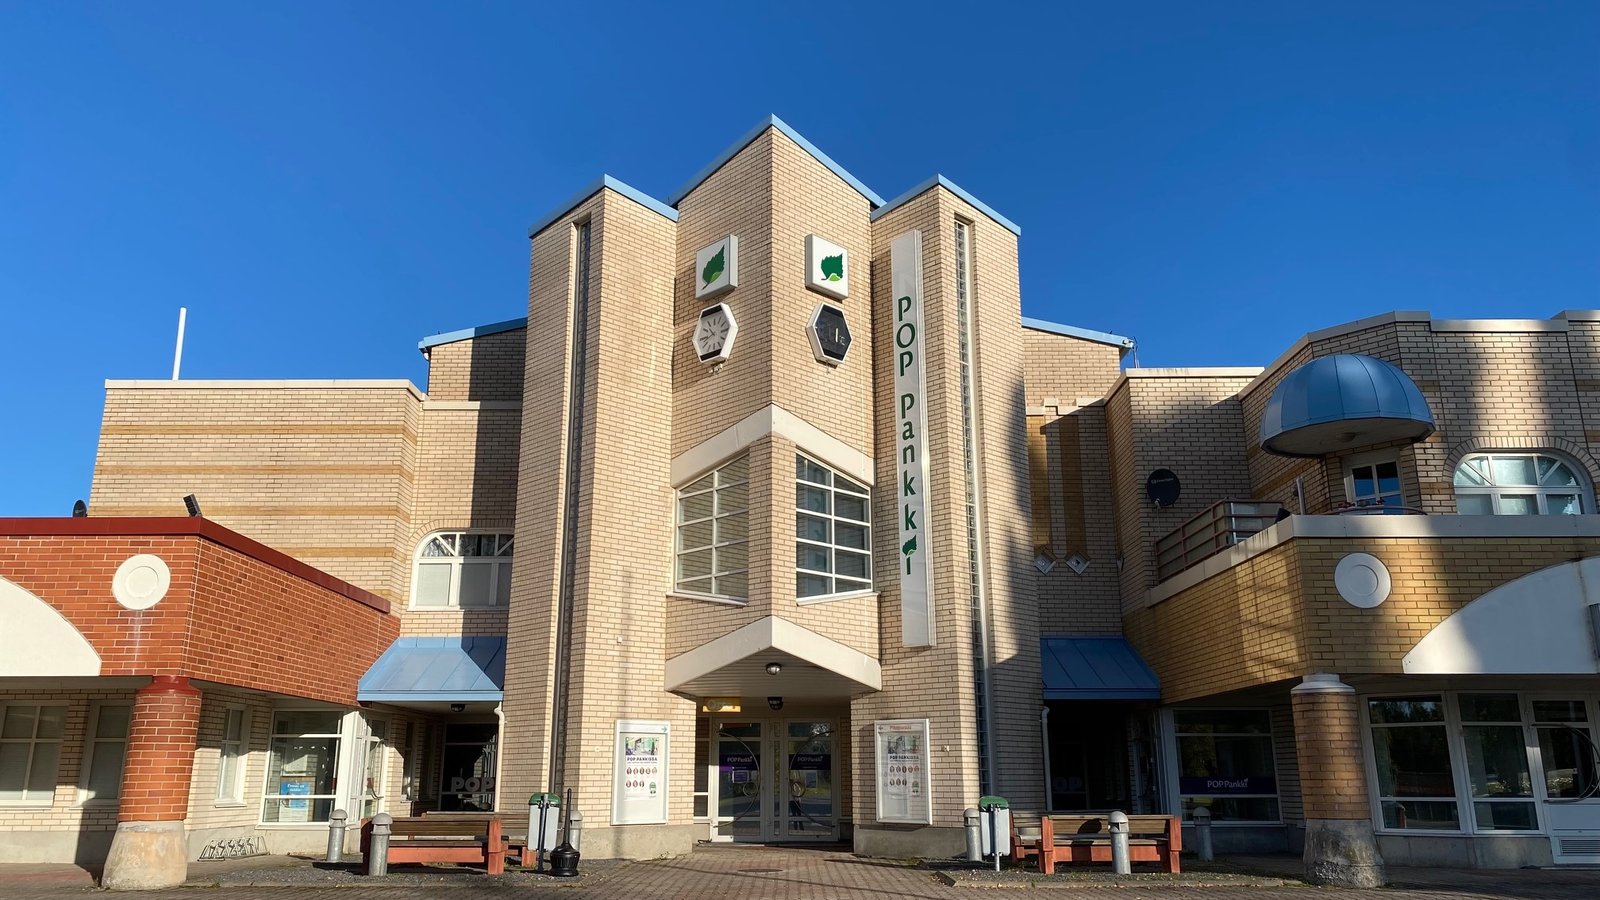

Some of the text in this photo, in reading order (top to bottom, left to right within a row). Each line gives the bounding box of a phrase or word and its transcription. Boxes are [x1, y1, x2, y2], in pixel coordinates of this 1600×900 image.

[896, 296, 918, 576] POP Pankki
[450, 776, 495, 793] POP
[1207, 777, 1249, 788] POP Pankki
